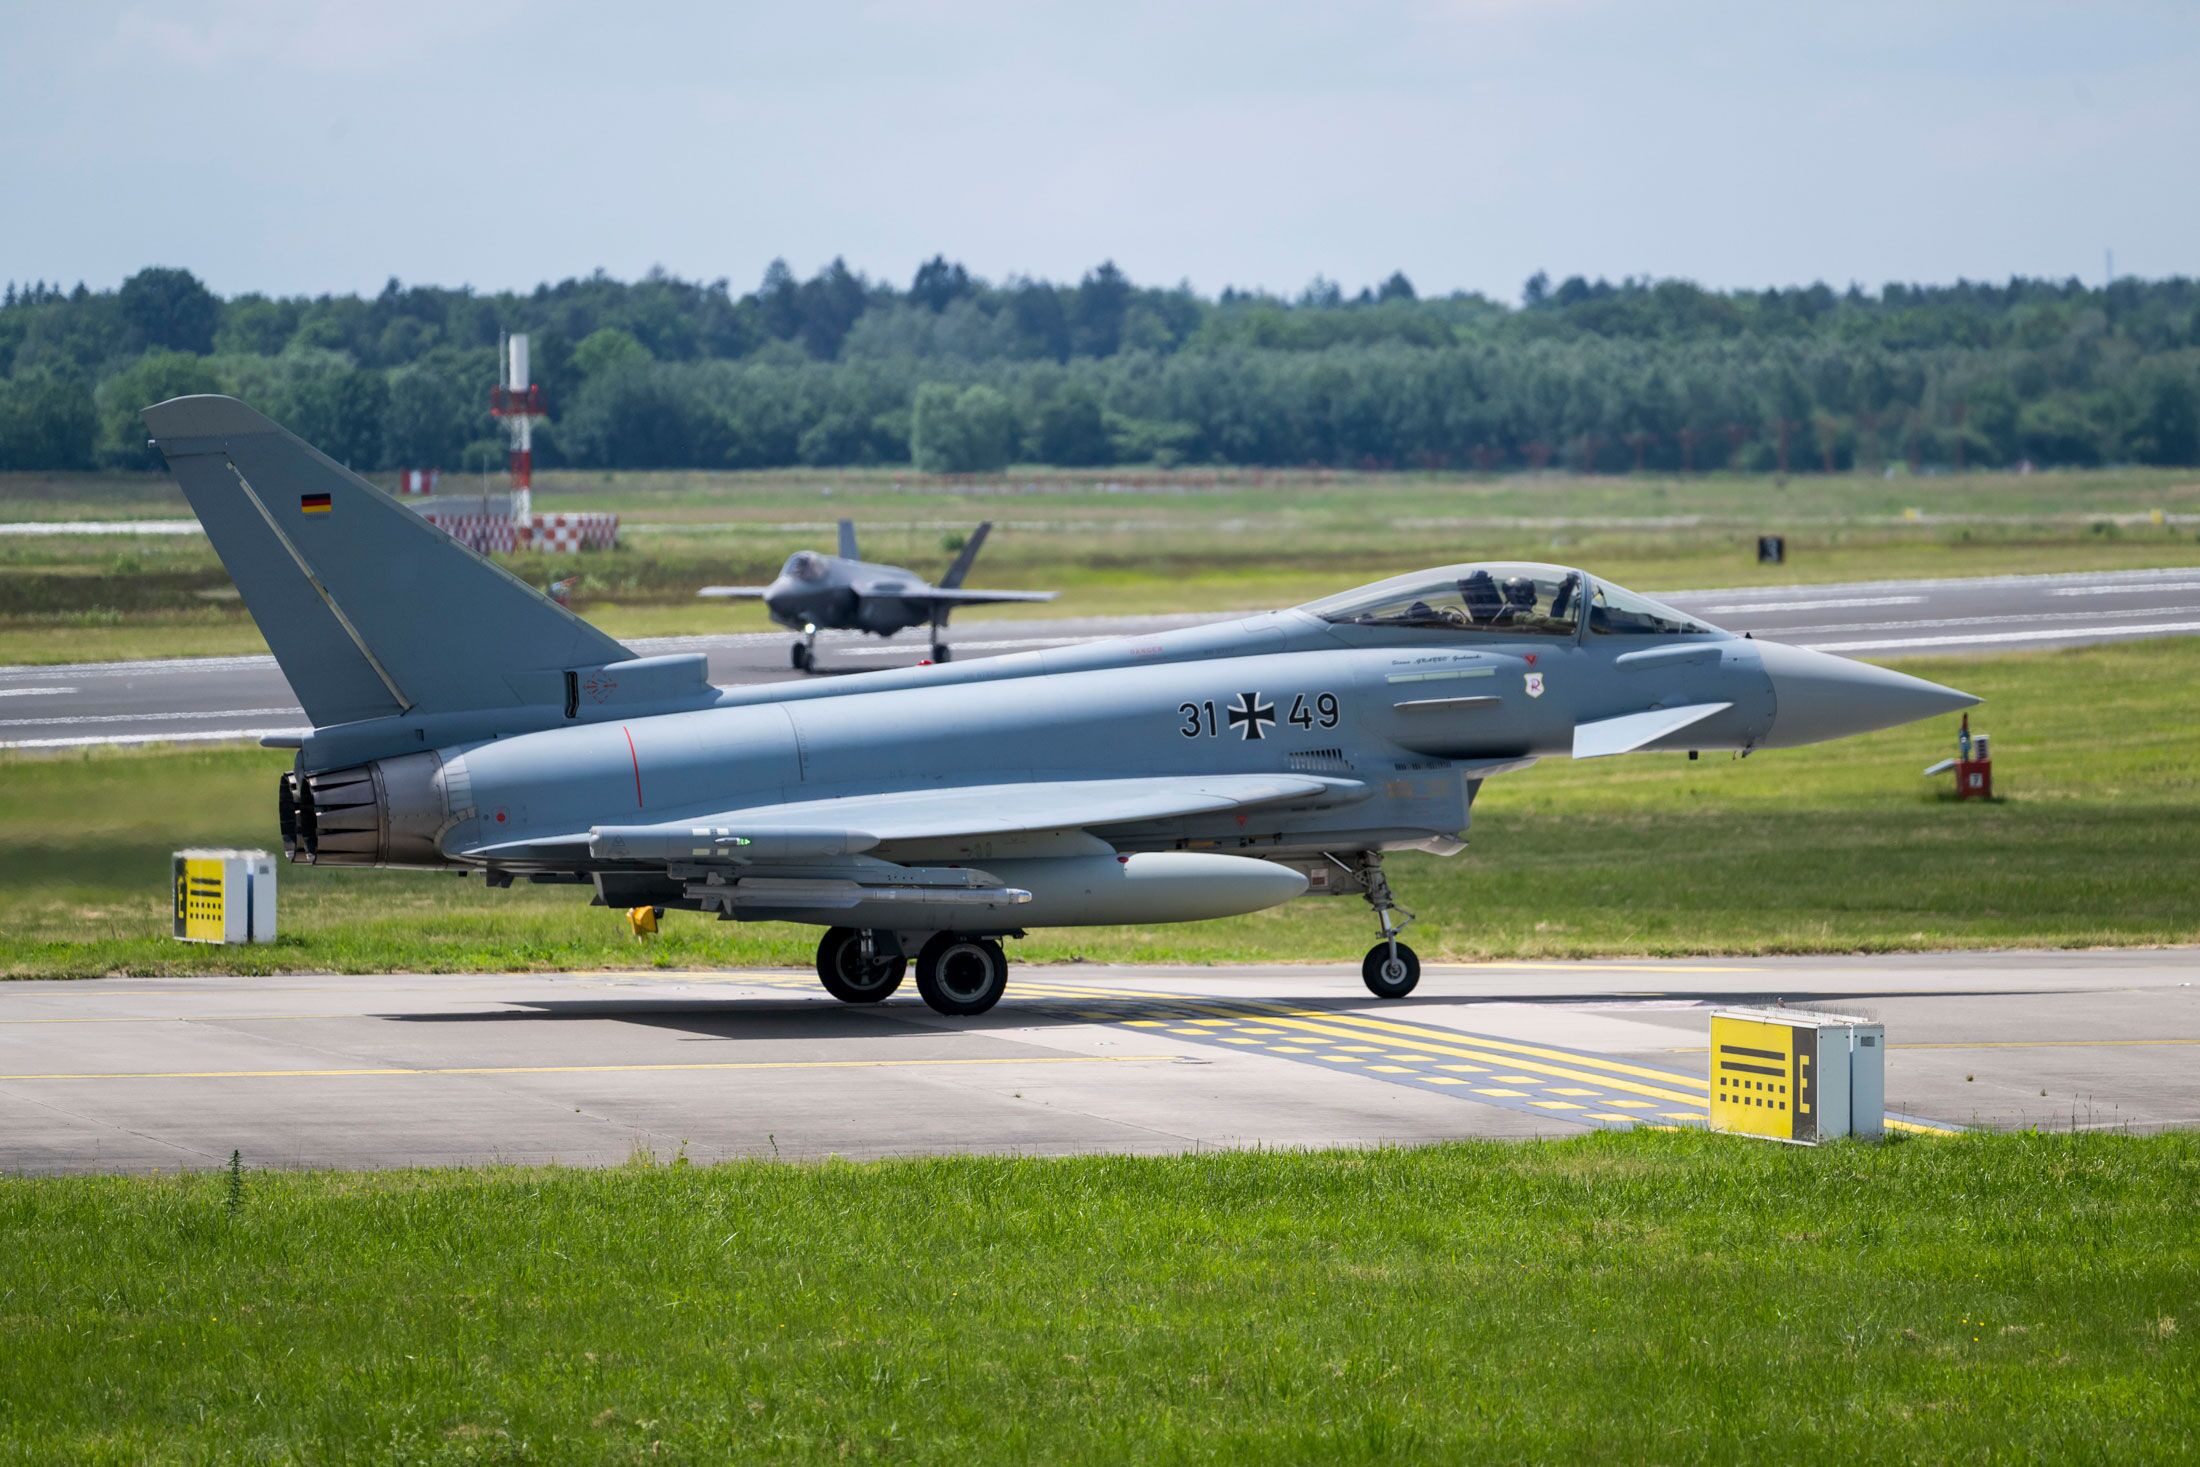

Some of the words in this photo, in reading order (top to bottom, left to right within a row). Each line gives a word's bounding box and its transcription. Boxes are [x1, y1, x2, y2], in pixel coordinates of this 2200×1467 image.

[1178, 699, 1218, 739] 31
[1288, 691, 1341, 731] 49
[177, 875, 184, 919] E
[1799, 1054, 1811, 1114] E
